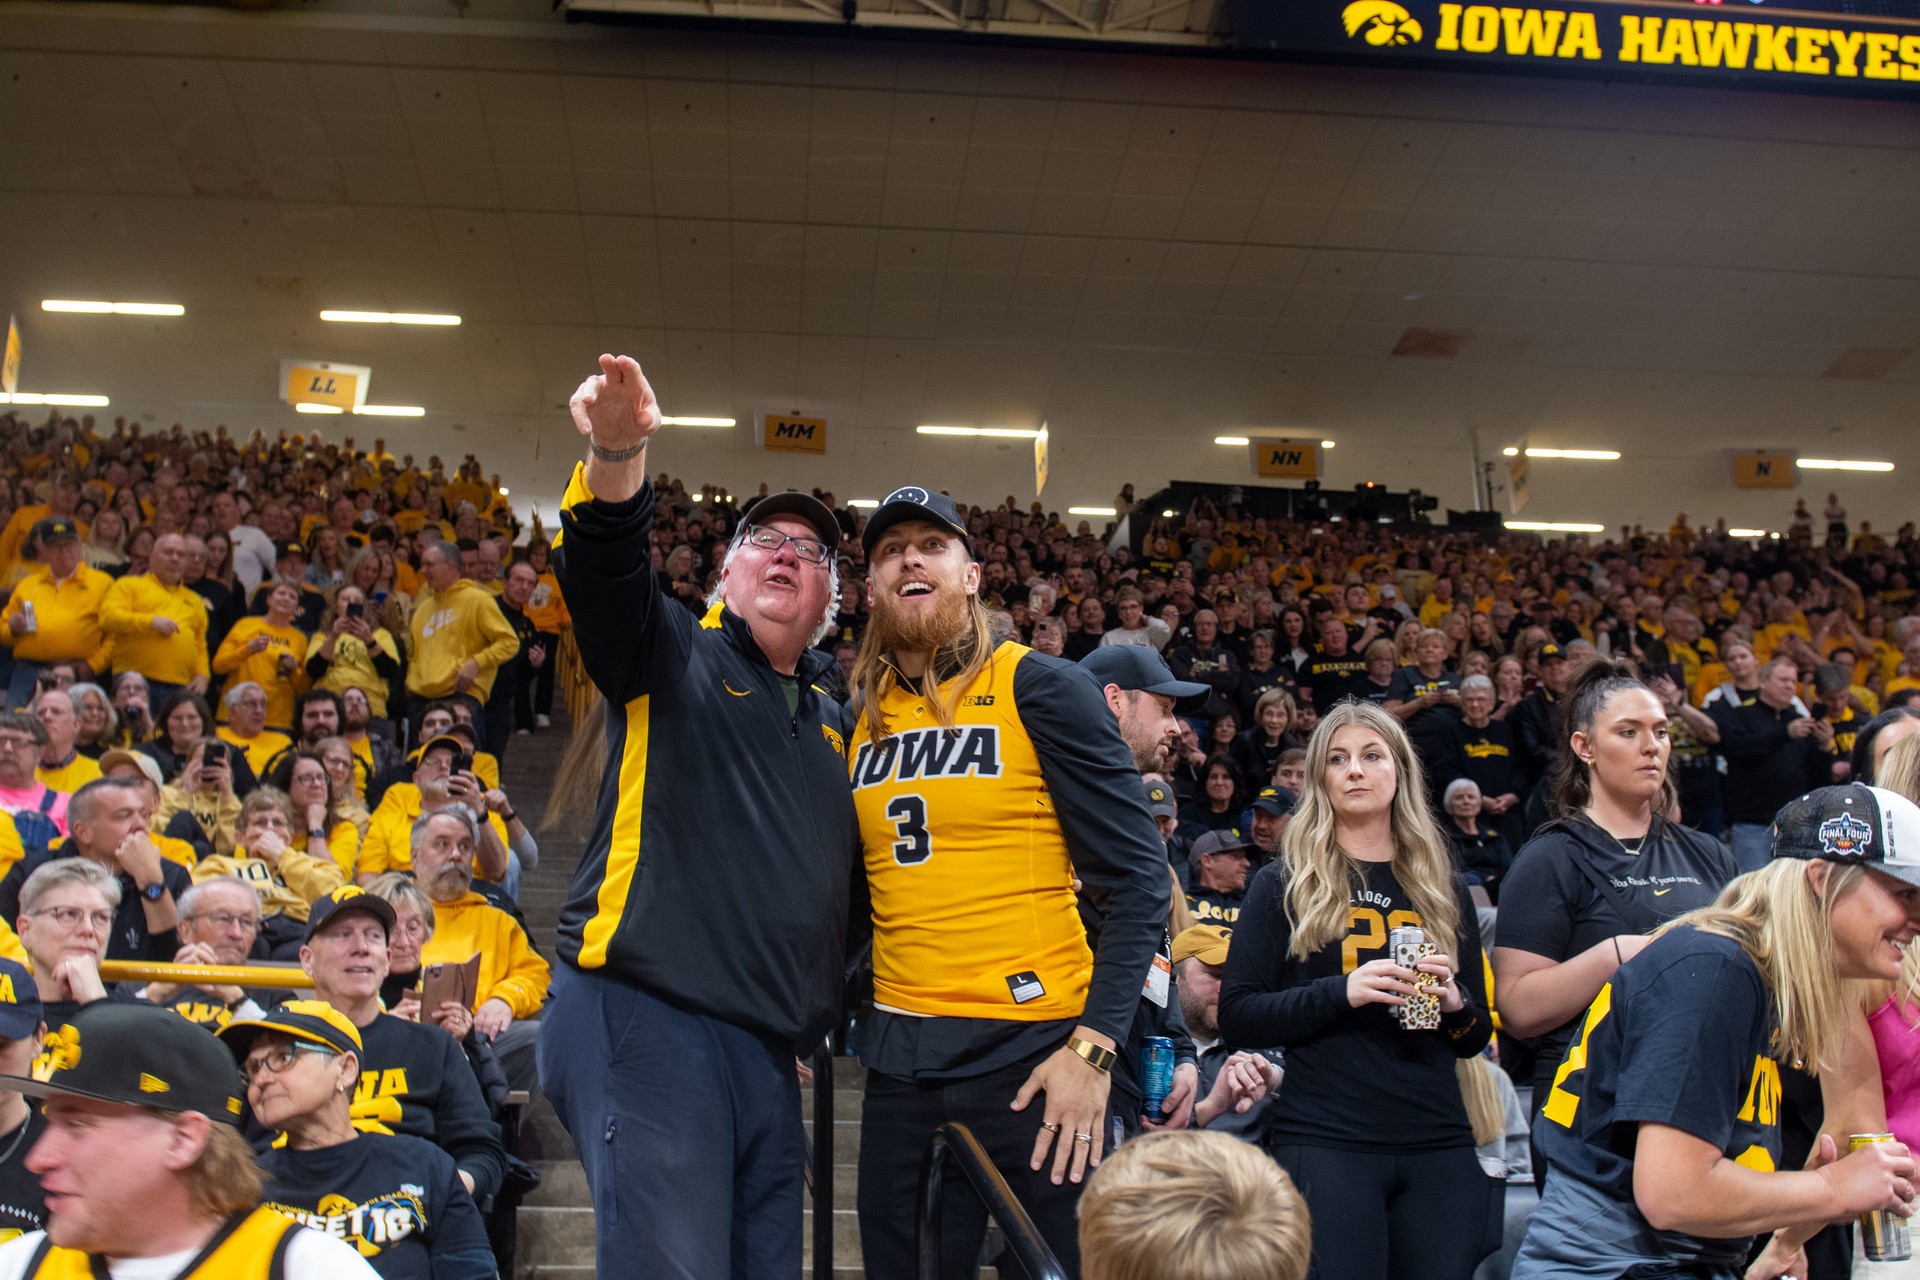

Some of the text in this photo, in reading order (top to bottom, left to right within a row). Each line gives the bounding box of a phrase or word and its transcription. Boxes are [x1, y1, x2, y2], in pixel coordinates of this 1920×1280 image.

[1435, 3, 1920, 82] IOWA HAWKEYES
[309, 376, 336, 394] LL
[774, 422, 816, 440] MM
[1270, 450, 1302, 465] NN
[1756, 462, 1771, 476] N
[850, 724, 1004, 793] IOWA
[885, 793, 933, 867] 3
[1822, 828, 1870, 841] FINAL FOUR
[1357, 890, 1392, 909] LOGO
[1016, 975, 1028, 984] L
